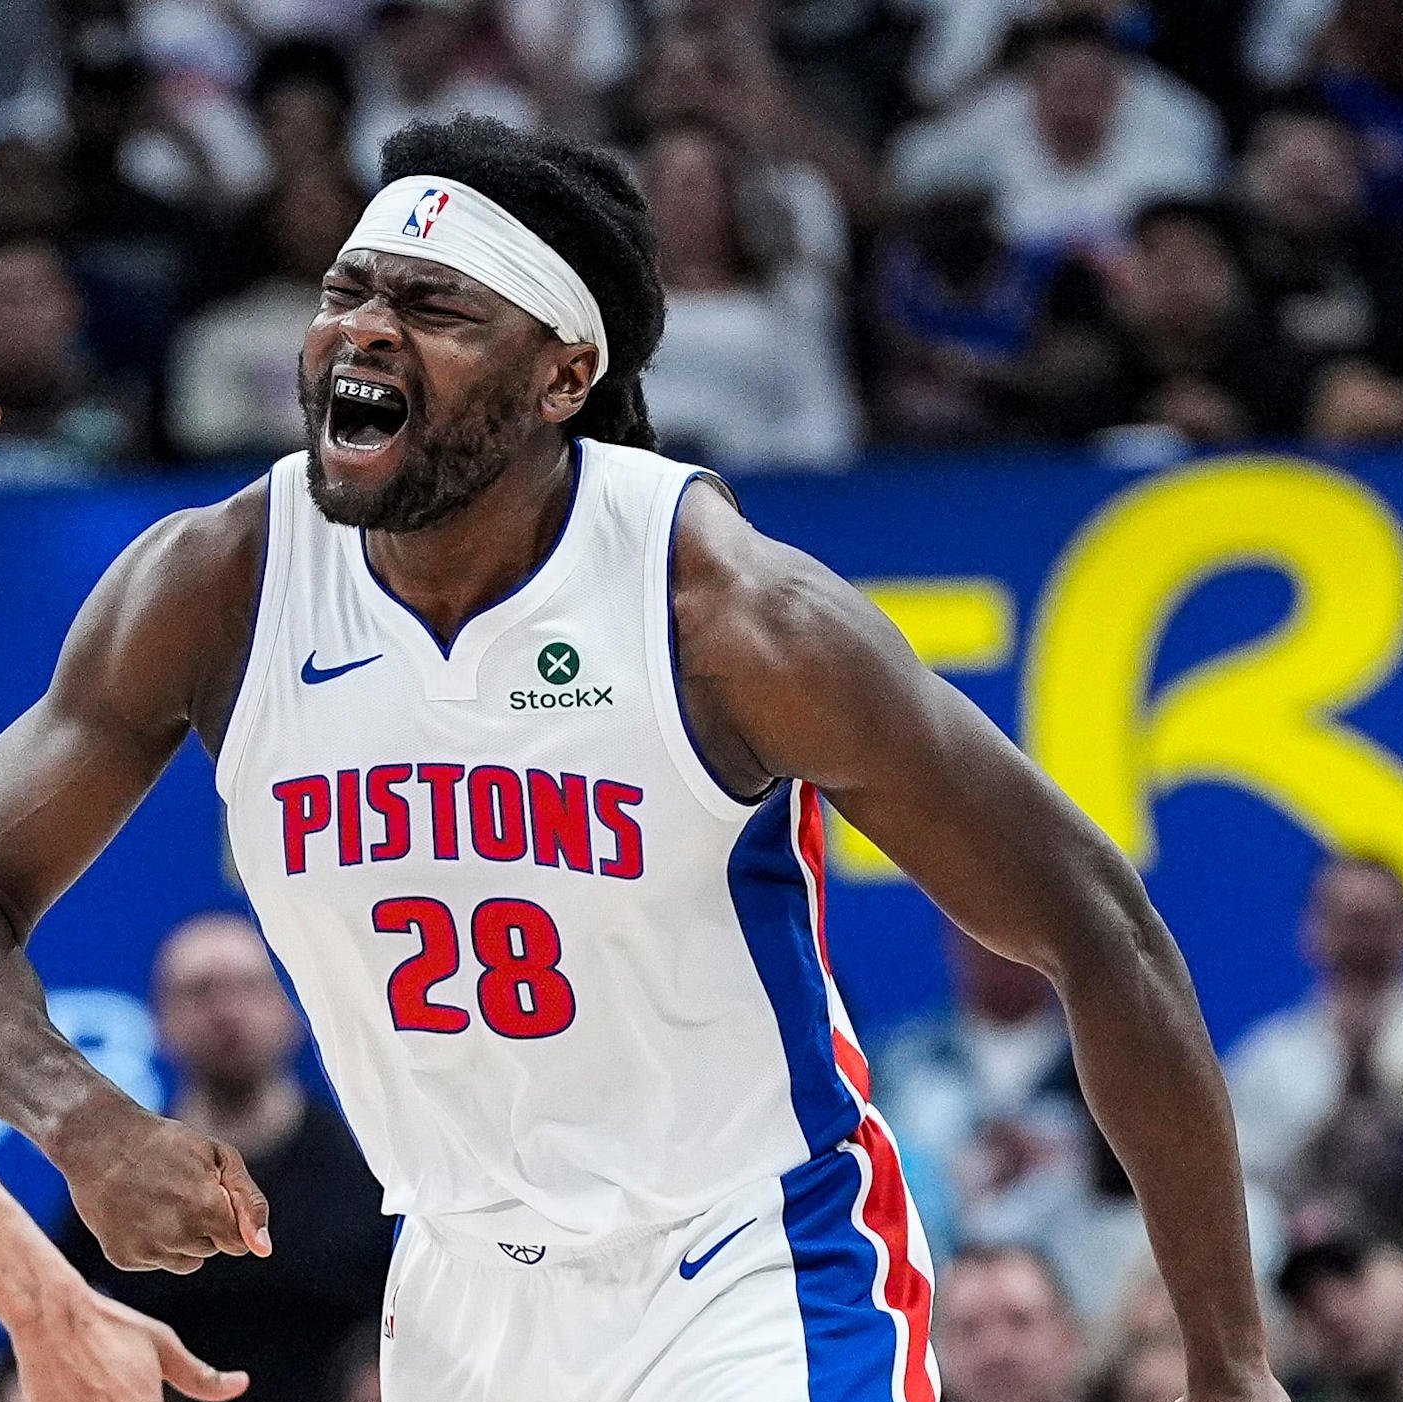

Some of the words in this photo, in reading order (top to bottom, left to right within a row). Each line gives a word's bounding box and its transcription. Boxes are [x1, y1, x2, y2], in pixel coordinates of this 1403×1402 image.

[509, 685, 614, 710] StockX
[272, 763, 644, 880] PISTONS
[372, 896, 576, 1040] 28
